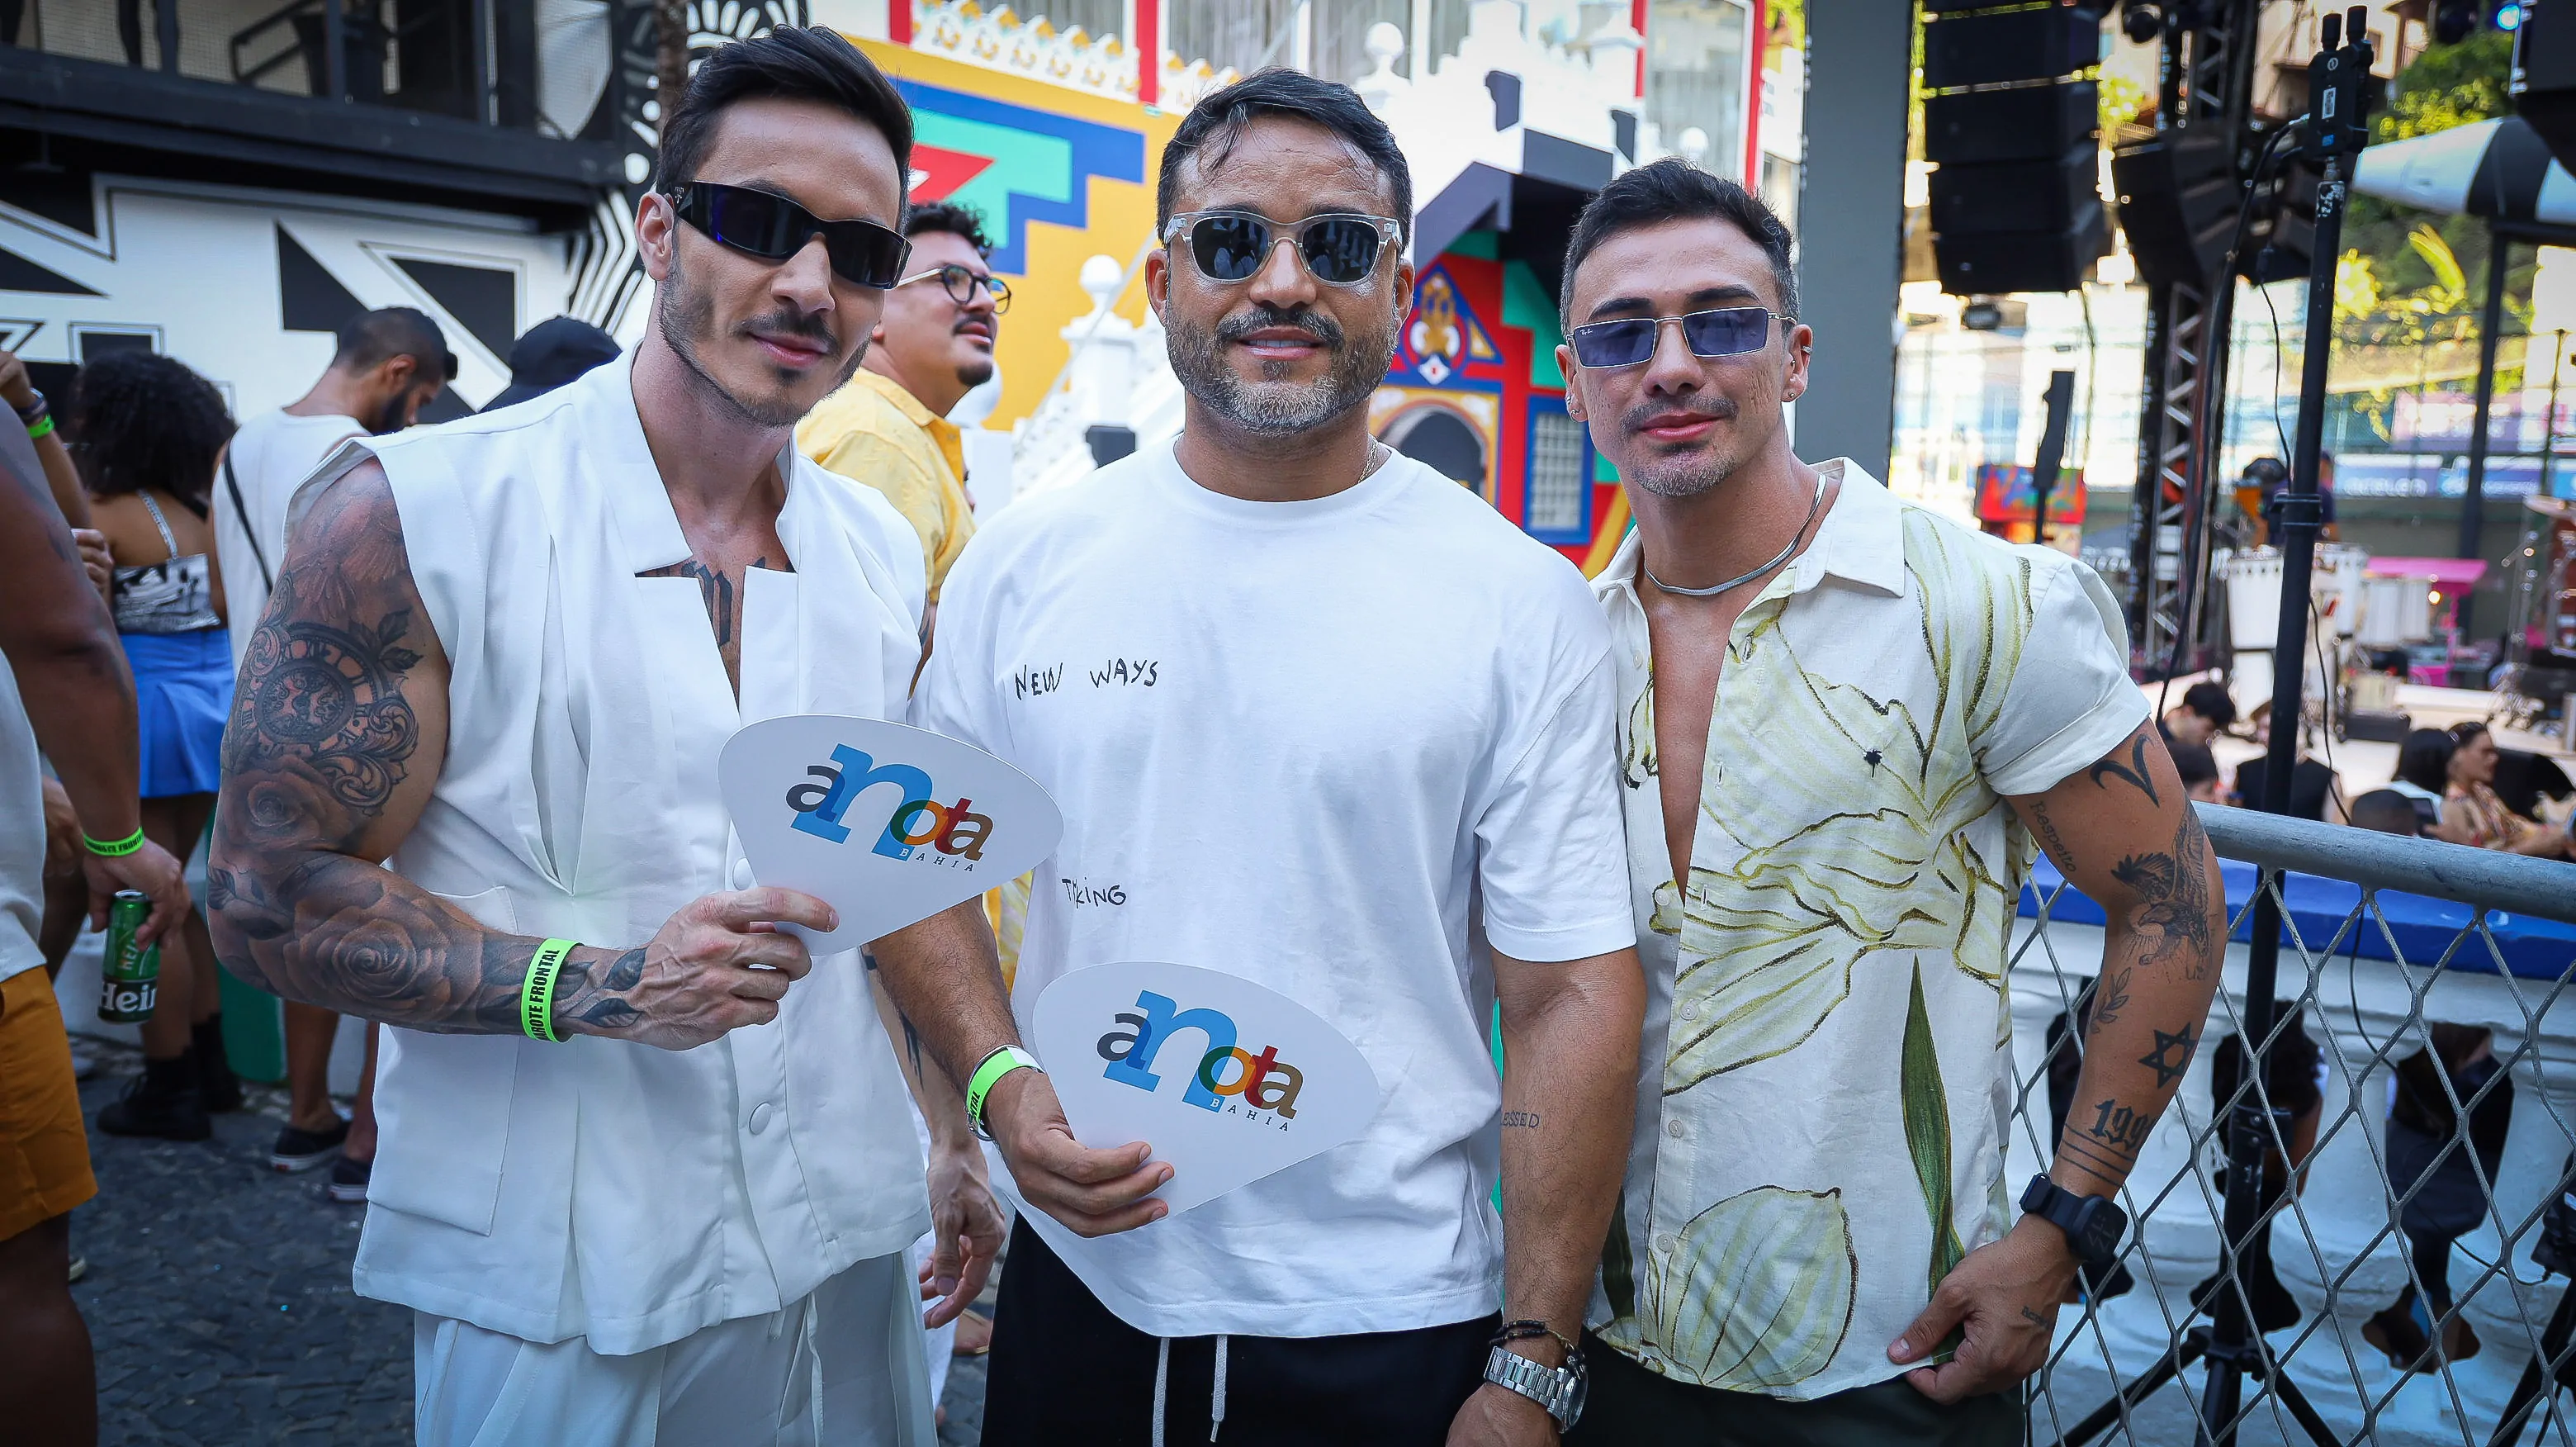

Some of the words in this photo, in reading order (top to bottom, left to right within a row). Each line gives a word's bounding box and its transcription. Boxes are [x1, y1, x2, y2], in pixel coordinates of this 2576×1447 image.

[1015, 662, 1063, 700] NEW
[1090, 658, 1158, 688] WAYS
[2029, 800, 2077, 873] Respeito
[898, 847, 975, 873] BAHIA
[528, 949, 561, 1003] FRONTAL
[1210, 1098, 1289, 1132] BAHIA
[1502, 1110, 1540, 1129] ESSED
